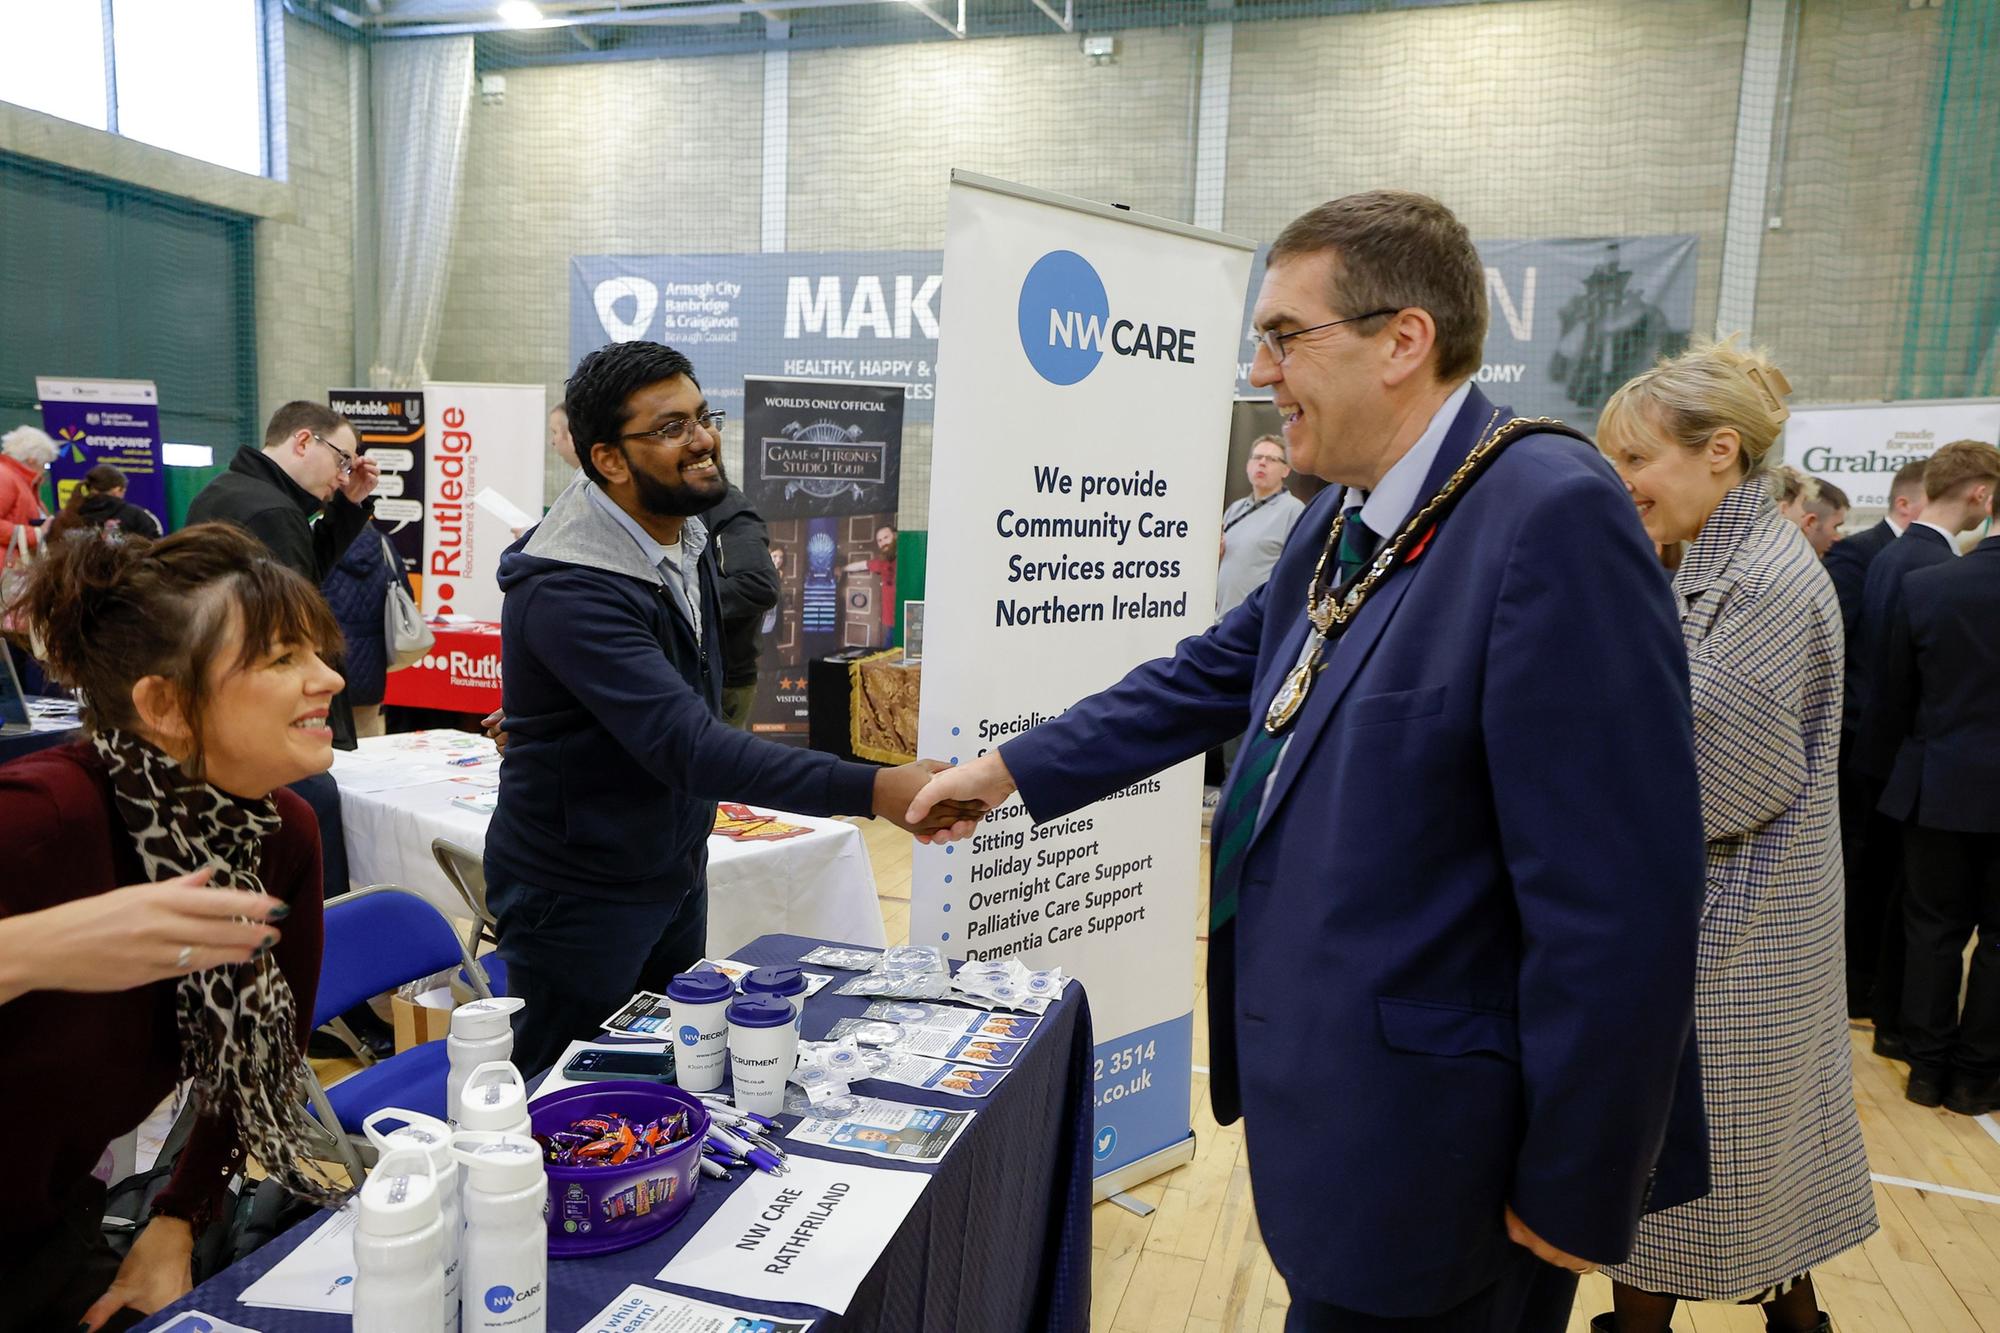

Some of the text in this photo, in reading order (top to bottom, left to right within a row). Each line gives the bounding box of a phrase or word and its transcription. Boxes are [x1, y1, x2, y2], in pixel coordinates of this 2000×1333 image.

[665, 281, 741, 299] Armagh City
[665, 298, 729, 315] Banbridge
[665, 314, 738, 331] & Craigavon
[1049, 308, 1196, 364] NW CARE
[784, 360, 931, 378] HEALTHY, HAPPY &
[765, 397, 886, 412] WORLD'S ONLY OFFICIAL
[85, 435, 152, 450] empower
[1886, 439, 1934, 452] for you
[1894, 429, 1934, 440] made
[783, 461, 827, 473] STUDIO
[1802, 446, 1929, 474] Graha
[465, 455, 477, 498] Training
[1034, 466, 1167, 502] We provide
[431, 407, 472, 577] Rutledge
[996, 509, 1188, 545] Community Care
[463, 510, 475, 579] Recruitment
[1008, 553, 1181, 583] Services across
[996, 591, 1187, 627] Northern Ireland
[450, 676, 491, 688] Recruitment
[984, 803, 1029, 823] erson
[972, 818, 1093, 855] Sitting Services
[971, 841, 1099, 883] Holiday Support
[969, 855, 1152, 911] Overnight Care Support
[967, 882, 1143, 939] Palliative Care Support
[966, 906, 1145, 963] Dementia Care Support
[684, 1033, 699, 1042] NW
[1110, 1040, 1156, 1075] 3514
[735, 1188, 803, 1251] NW CARE
[764, 1182, 850, 1274] RATHFRILAND
[493, 1282, 541, 1306] NW CARE
[605, 1298, 643, 1328] while
